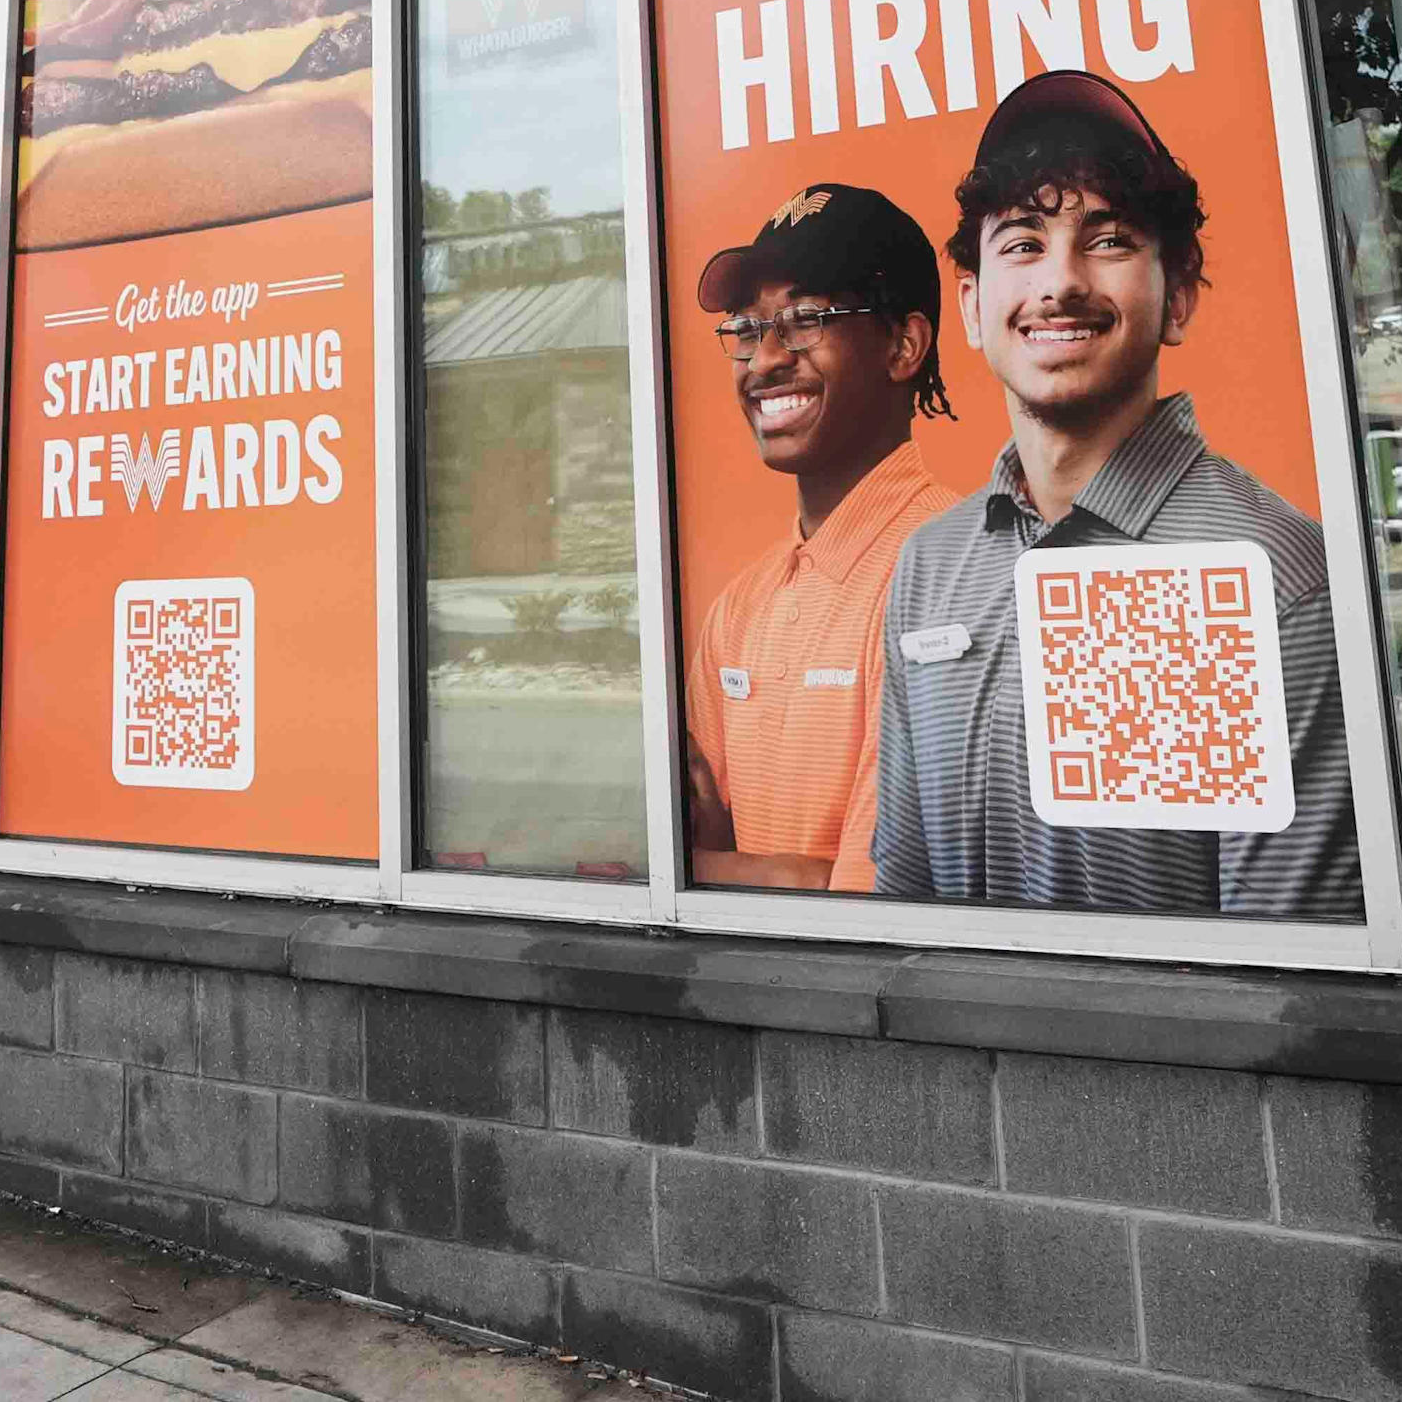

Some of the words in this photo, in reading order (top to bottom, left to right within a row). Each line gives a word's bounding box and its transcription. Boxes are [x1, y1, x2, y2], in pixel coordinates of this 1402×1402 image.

[114, 284, 160, 332] Get
[164, 280, 207, 319] the
[211, 282, 259, 324] app
[43, 351, 158, 417] START
[165, 329, 343, 405] EARNING
[42, 413, 343, 519] REWARDS
